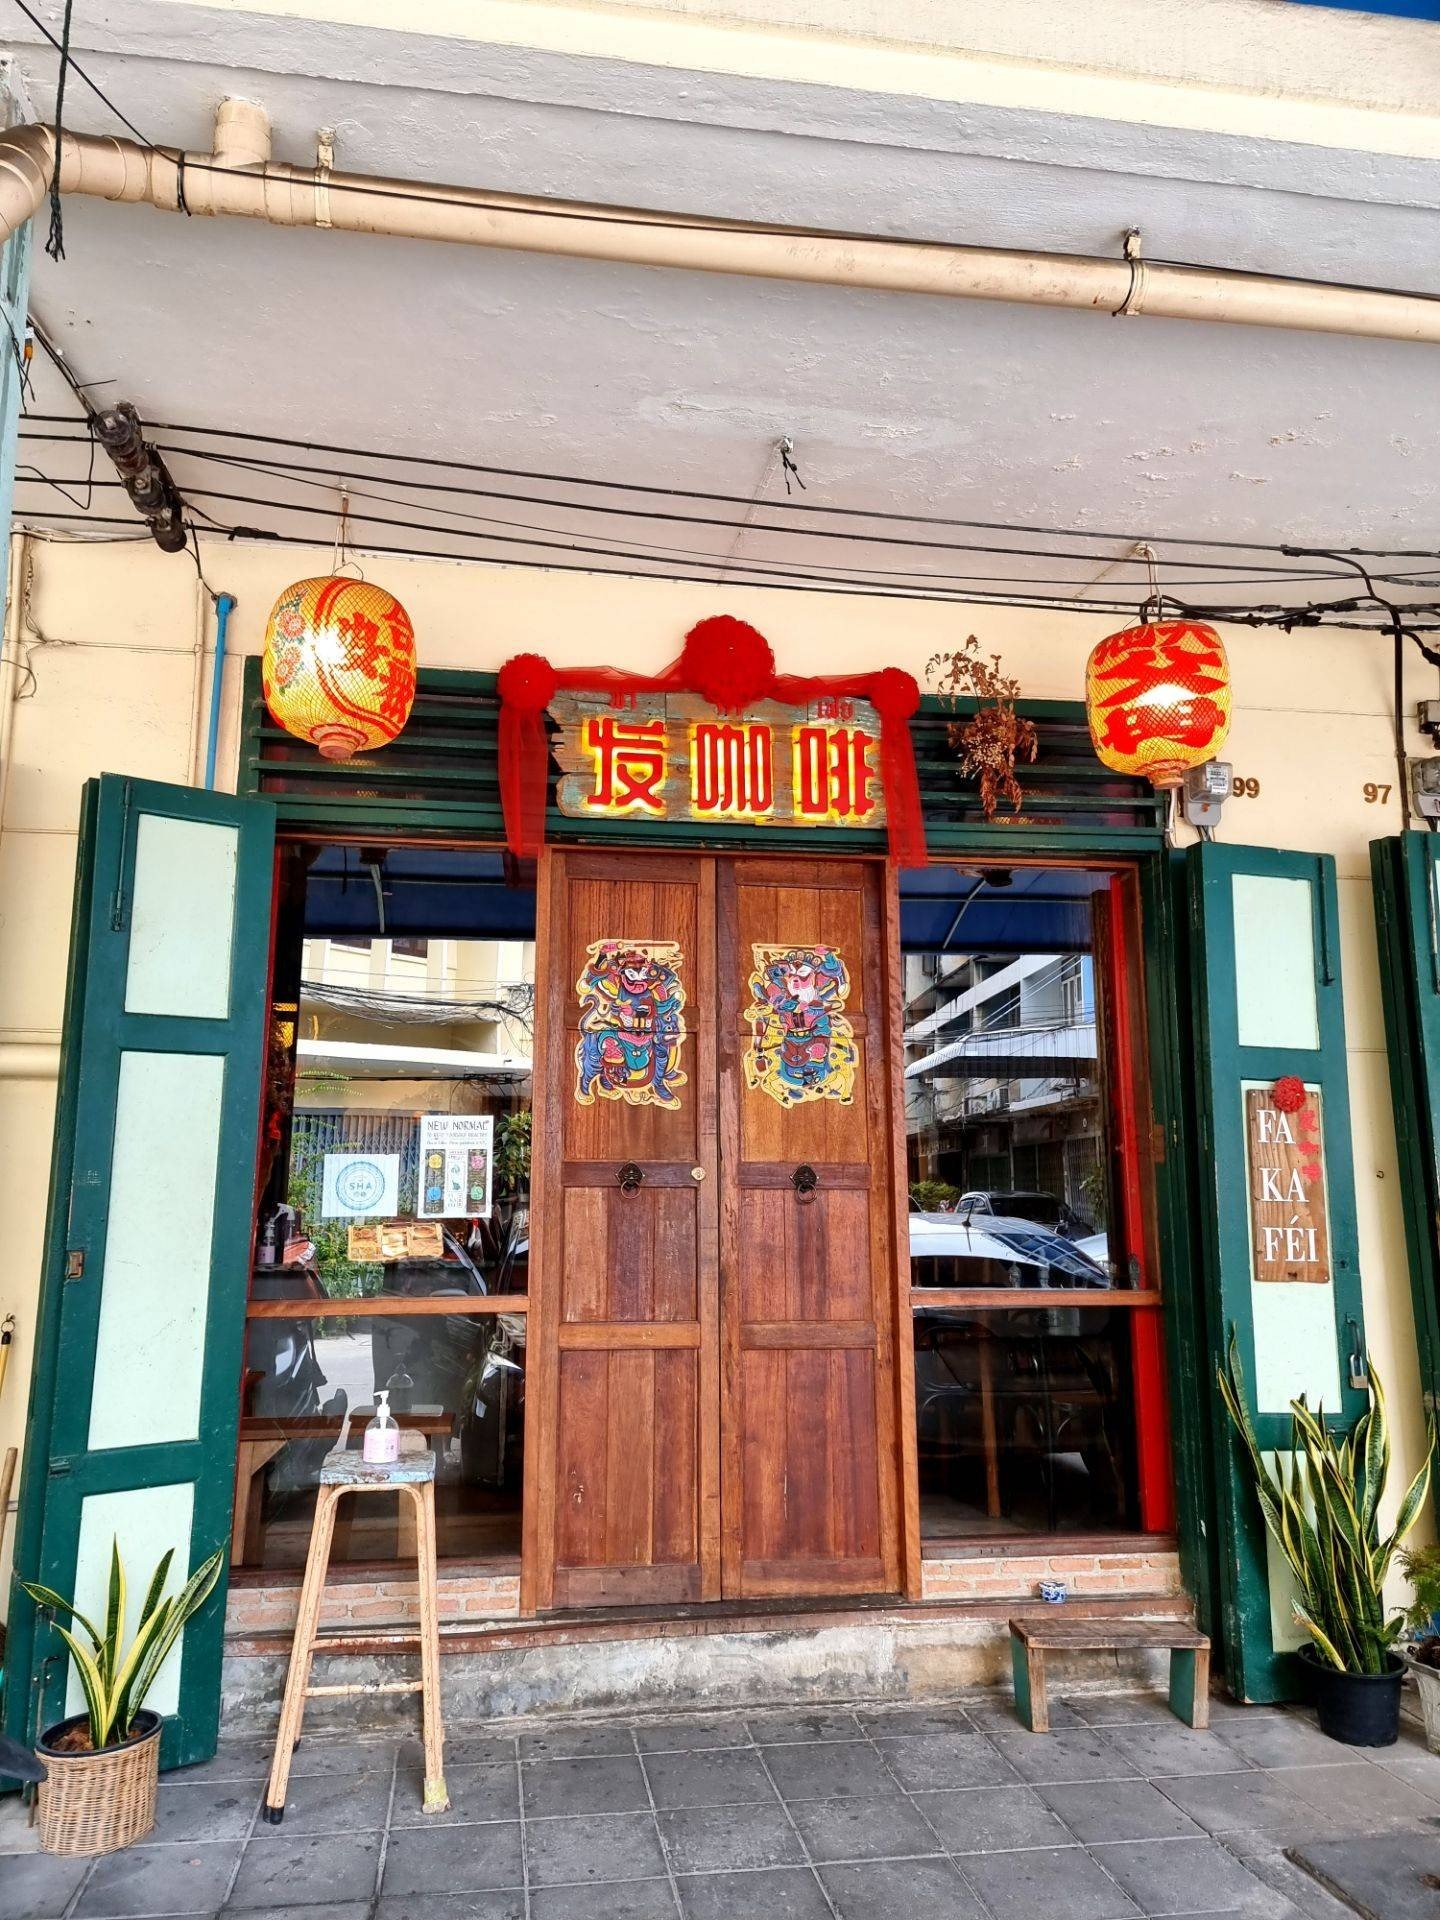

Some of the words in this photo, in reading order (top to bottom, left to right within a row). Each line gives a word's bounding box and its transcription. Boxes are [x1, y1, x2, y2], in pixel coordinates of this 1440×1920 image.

[586, 717, 876, 816] 发咖啡
[1232, 777, 1260, 799] 99
[1363, 782, 1392, 804] 97
[427, 1120, 448, 1131] NEW
[452, 1120, 488, 1131] NORMAL
[1257, 1109, 1296, 1144] FA
[349, 1182, 372, 1191] SHA
[1259, 1167, 1309, 1203] KA
[1262, 1215, 1319, 1263] FÉI
